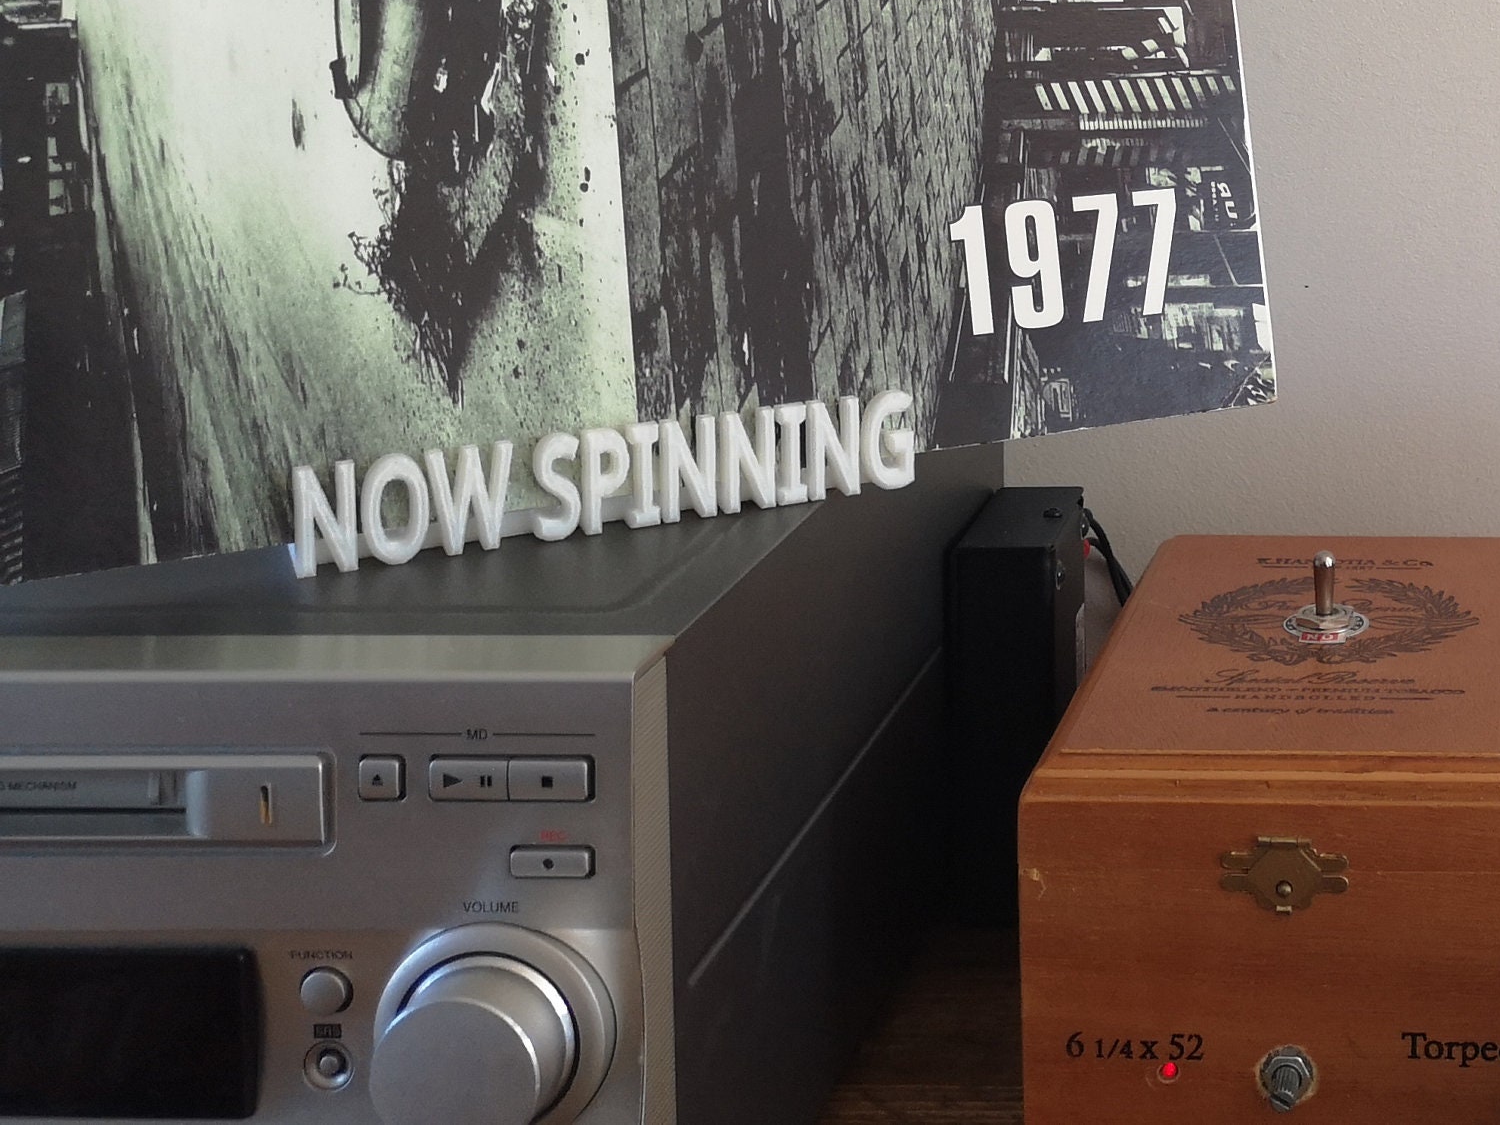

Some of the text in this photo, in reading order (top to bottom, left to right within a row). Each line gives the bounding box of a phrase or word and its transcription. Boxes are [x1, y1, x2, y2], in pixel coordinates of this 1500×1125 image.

[949, 188, 1176, 337] 1977
[291, 389, 916, 581] NOW SPINNING
[466, 729, 488, 740] MD
[463, 901, 520, 913] VOLUME
[290, 950, 353, 960] FUNCTION
[1066, 1031, 1205, 1061] 6 1/4 x 52
